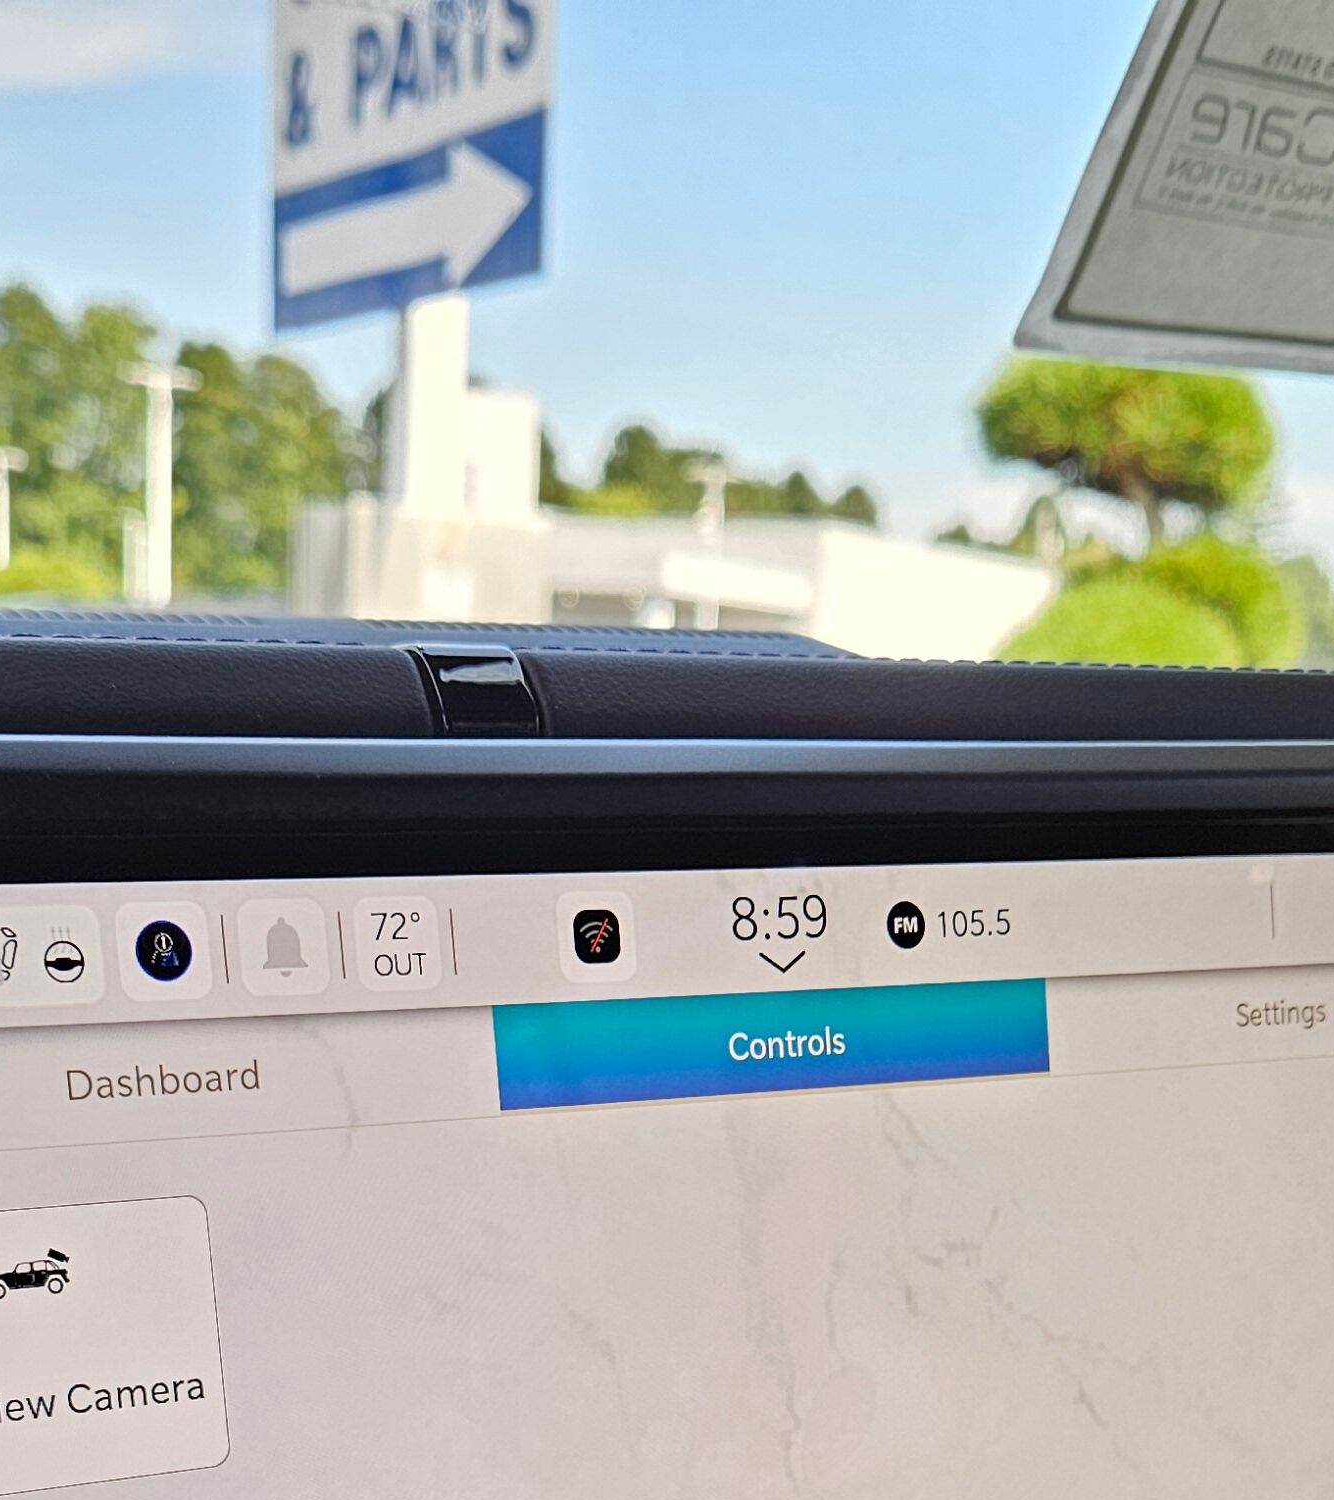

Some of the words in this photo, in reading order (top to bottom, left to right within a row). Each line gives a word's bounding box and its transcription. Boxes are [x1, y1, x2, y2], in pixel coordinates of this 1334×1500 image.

[284, 52, 312, 147] &
[349, 0, 535, 128] PARTS
[370, 911, 421, 941] 72°
[732, 894, 827, 942] 8:59
[893, 915, 920, 935] FM
[938, 908, 1011, 938] 105.5
[373, 951, 427, 978] OUT
[1235, 1000, 1327, 1030] Settings
[728, 1025, 846, 1061] Controls
[66, 1058, 260, 1101] Dashboard
[67, 1378, 205, 1415] Camera
